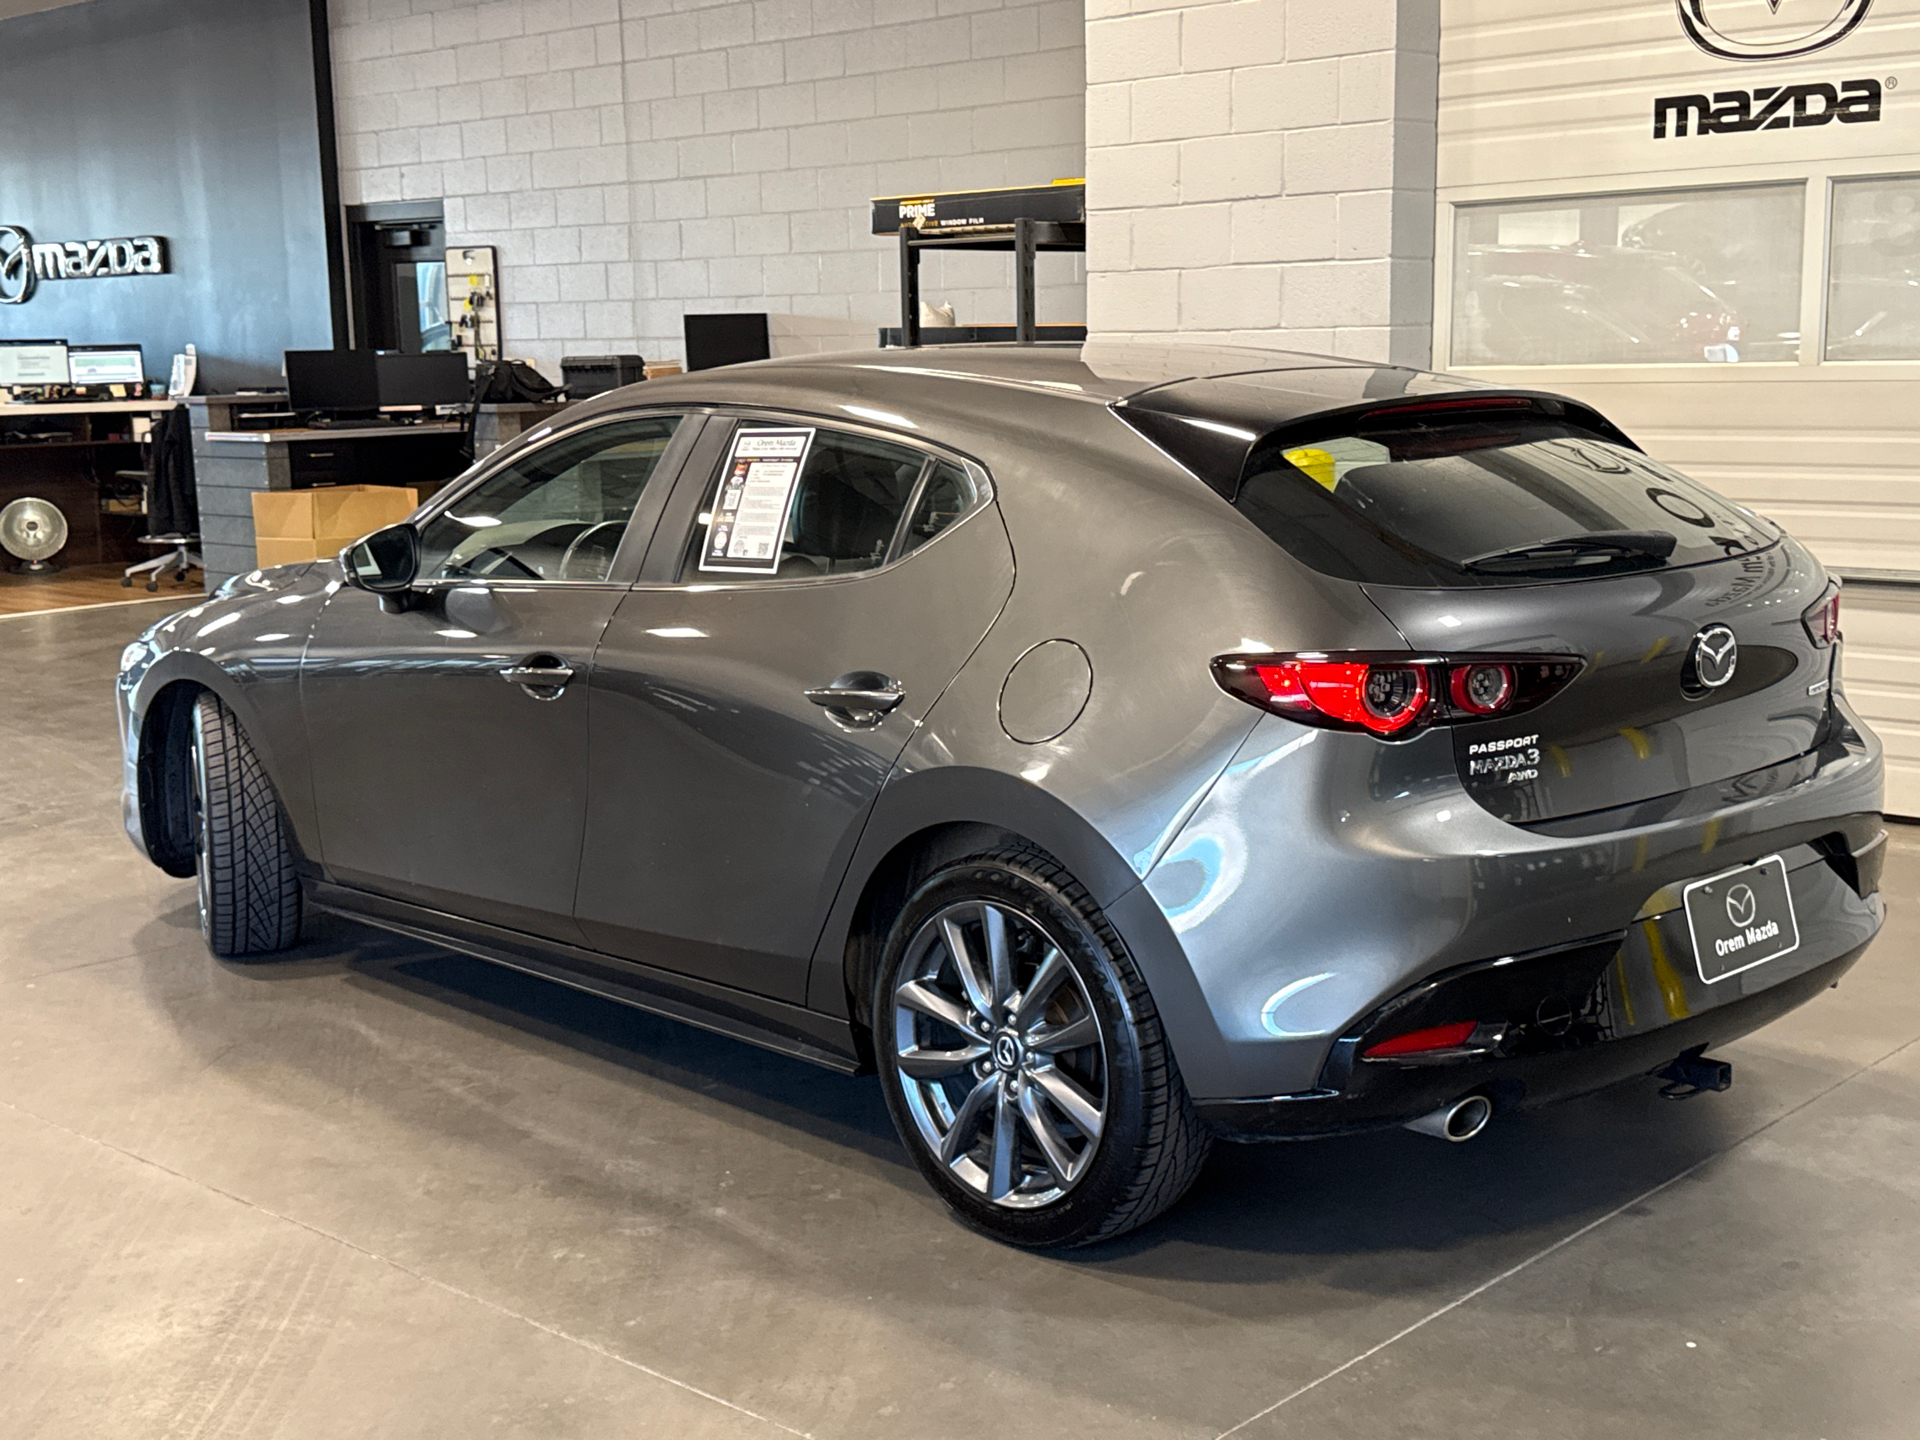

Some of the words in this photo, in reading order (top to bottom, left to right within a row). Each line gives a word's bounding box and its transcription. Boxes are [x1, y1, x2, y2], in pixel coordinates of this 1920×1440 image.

[1653, 78, 1882, 139] mazda
[899, 204, 935, 218] PRIME
[31, 236, 162, 280] mazda
[1469, 734, 1539, 755] PASSPORT
[1507, 768, 1539, 784] AWD
[1715, 936, 1745, 956] Orem
[1745, 920, 1779, 945] Mazda
